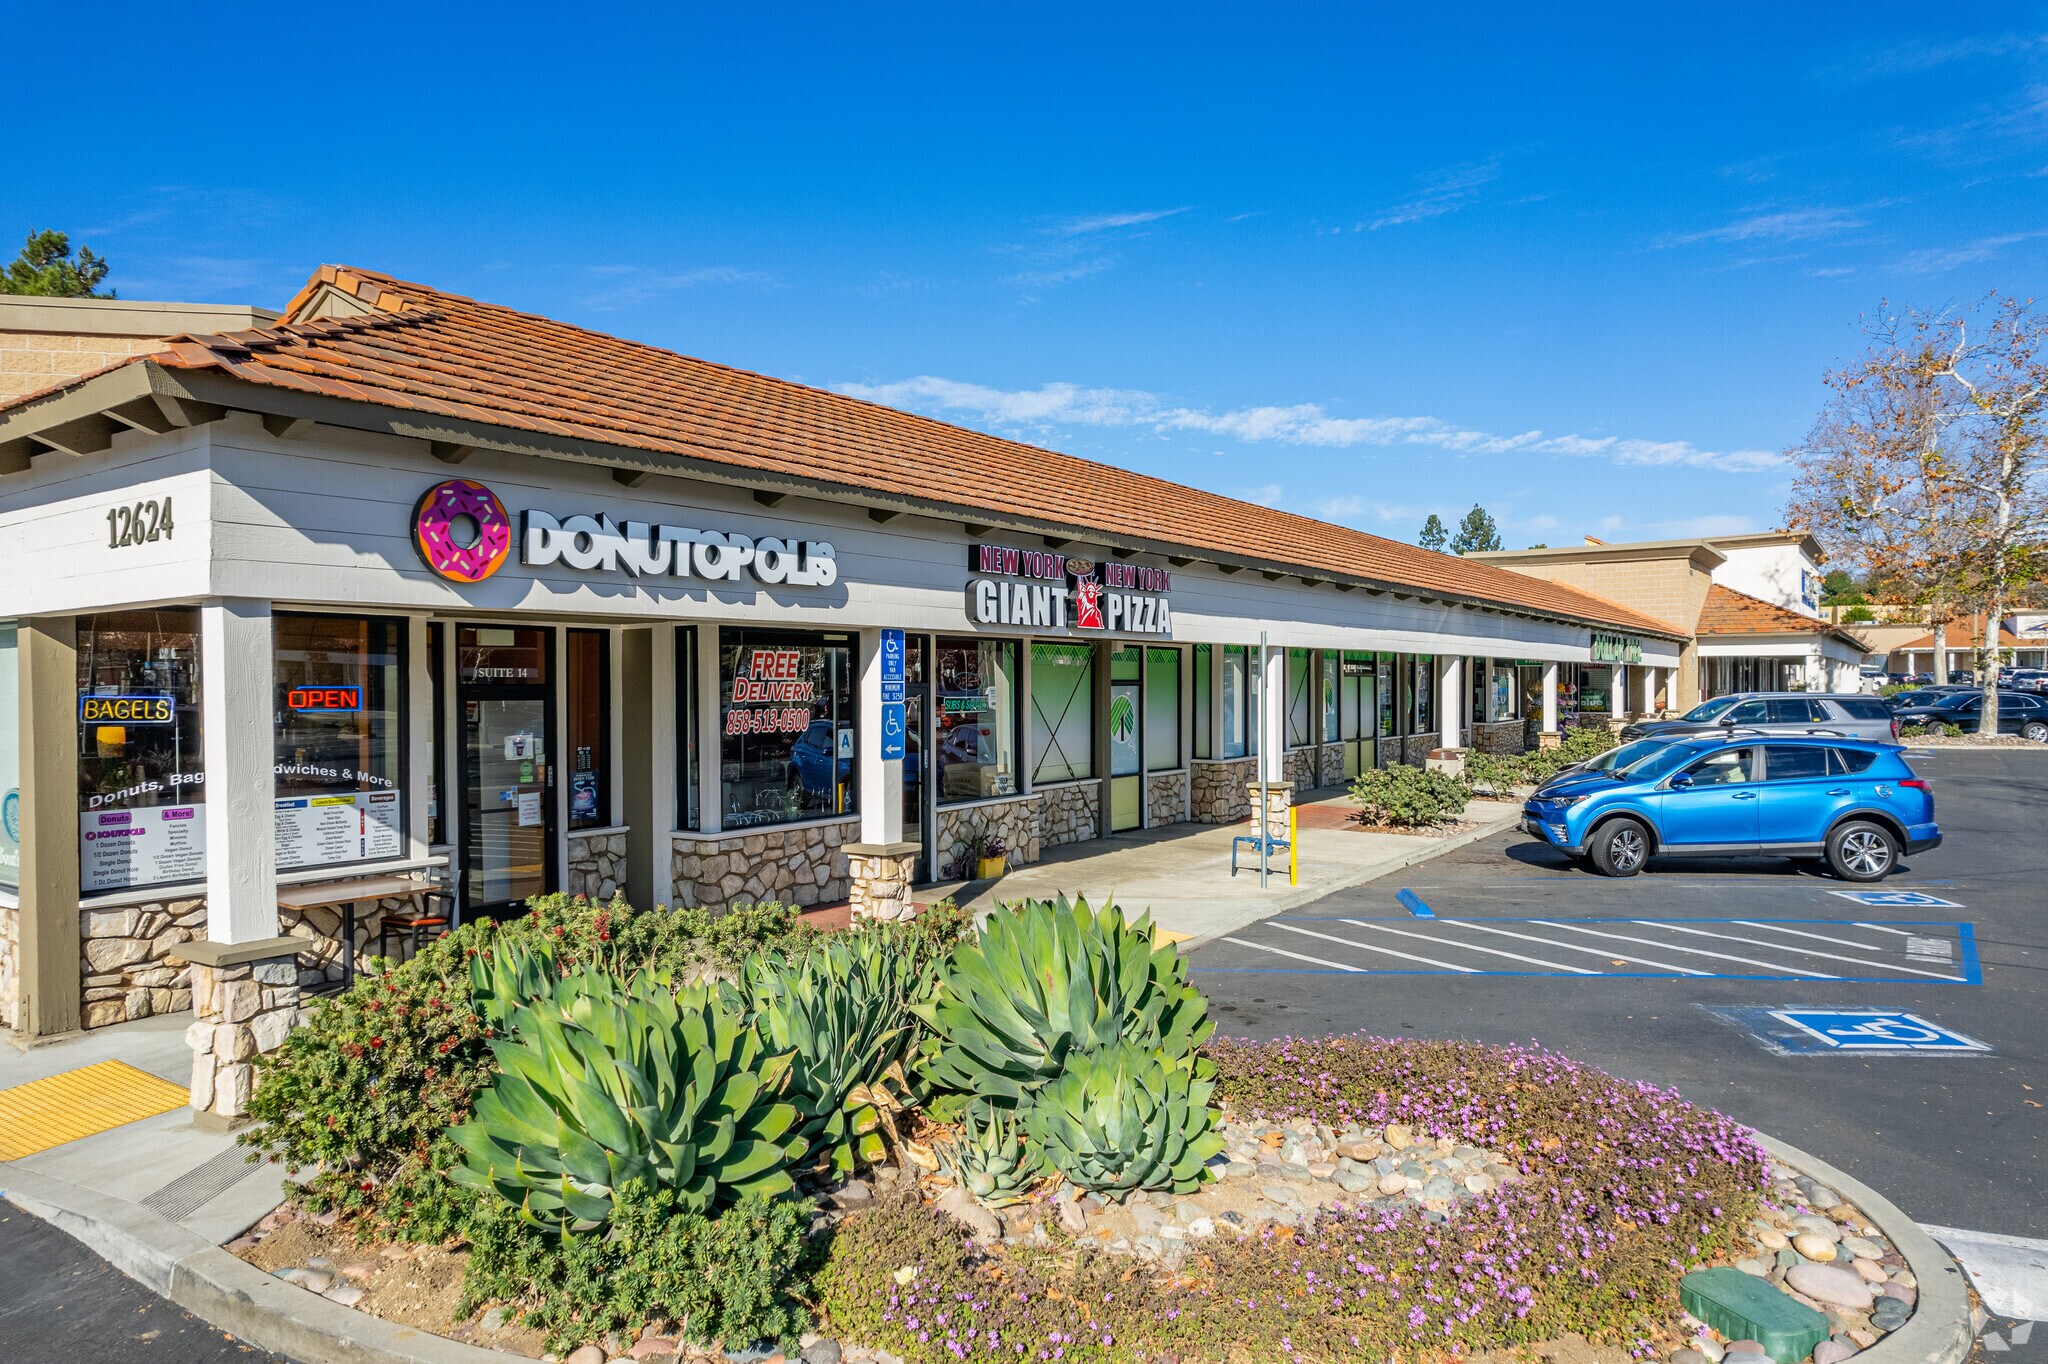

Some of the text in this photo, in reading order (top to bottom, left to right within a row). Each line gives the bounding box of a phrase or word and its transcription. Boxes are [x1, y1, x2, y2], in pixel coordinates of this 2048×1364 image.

[106, 497, 174, 549] 12624
[521, 509, 837, 587] DONUTOPOLIS
[980, 544, 1171, 592] NEW YORK NEW YORK
[976, 580, 1172, 633] GIANT PIZZA
[1596, 634, 1642, 663] DOLLAR TREE
[478, 668, 528, 678] SUITE 14
[750, 650, 800, 680] FREE
[288, 690, 357, 708] OPEN
[733, 677, 814, 703] DELIVERY
[85, 700, 168, 720] BAGELS
[946, 700, 960, 710] SUBS
[961, 700, 964, 709] &
[726, 708, 810, 736] 858-513-0500
[842, 734, 850, 748] A
[89, 780, 164, 808] Donuts,
[342, 769, 353, 779] &
[358, 771, 392, 787] More
[101, 815, 129, 823] Donuts
[97, 828, 145, 839] DONUTOPOLIS
